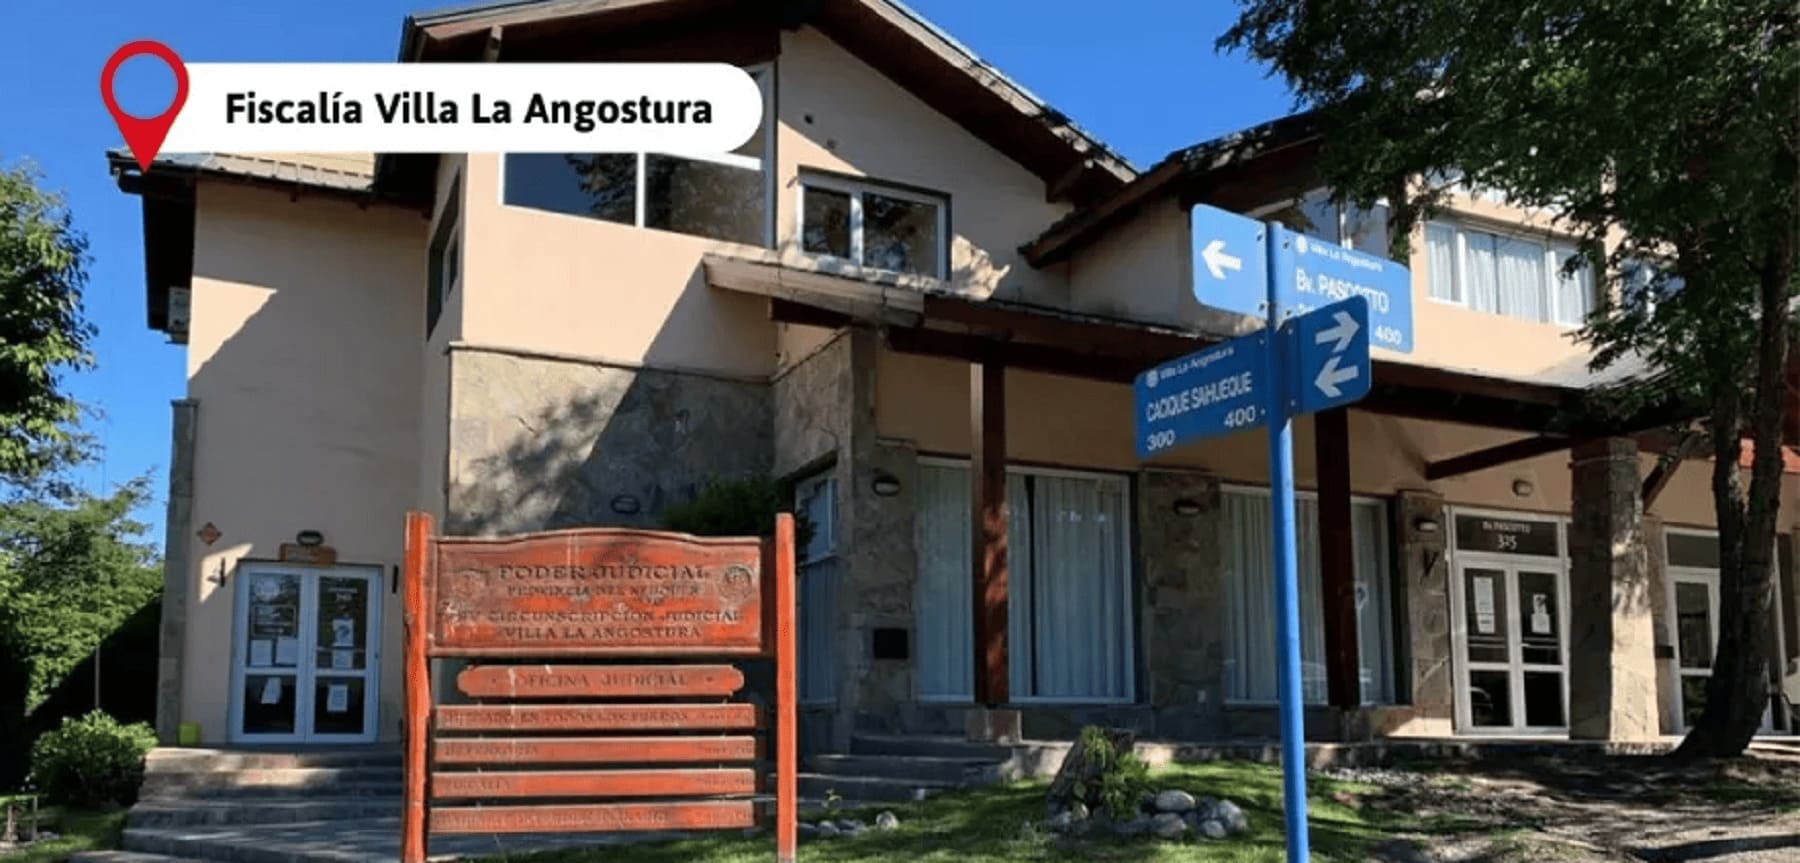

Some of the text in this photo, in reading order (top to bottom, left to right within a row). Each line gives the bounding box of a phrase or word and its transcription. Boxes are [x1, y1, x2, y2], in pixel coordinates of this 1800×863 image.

[1146, 371, 1253, 423] CACIQUE SAHUEQUE
[1223, 405, 1256, 428] 400
[1146, 429, 1177, 452] 300
[499, 564, 710, 581] PODER JUDICIAL
[661, 609, 742, 623] JUDICIAL
[503, 626, 703, 641] VILLA LA ANGOSTURA
[600, 671, 690, 687] JUDICIAL
